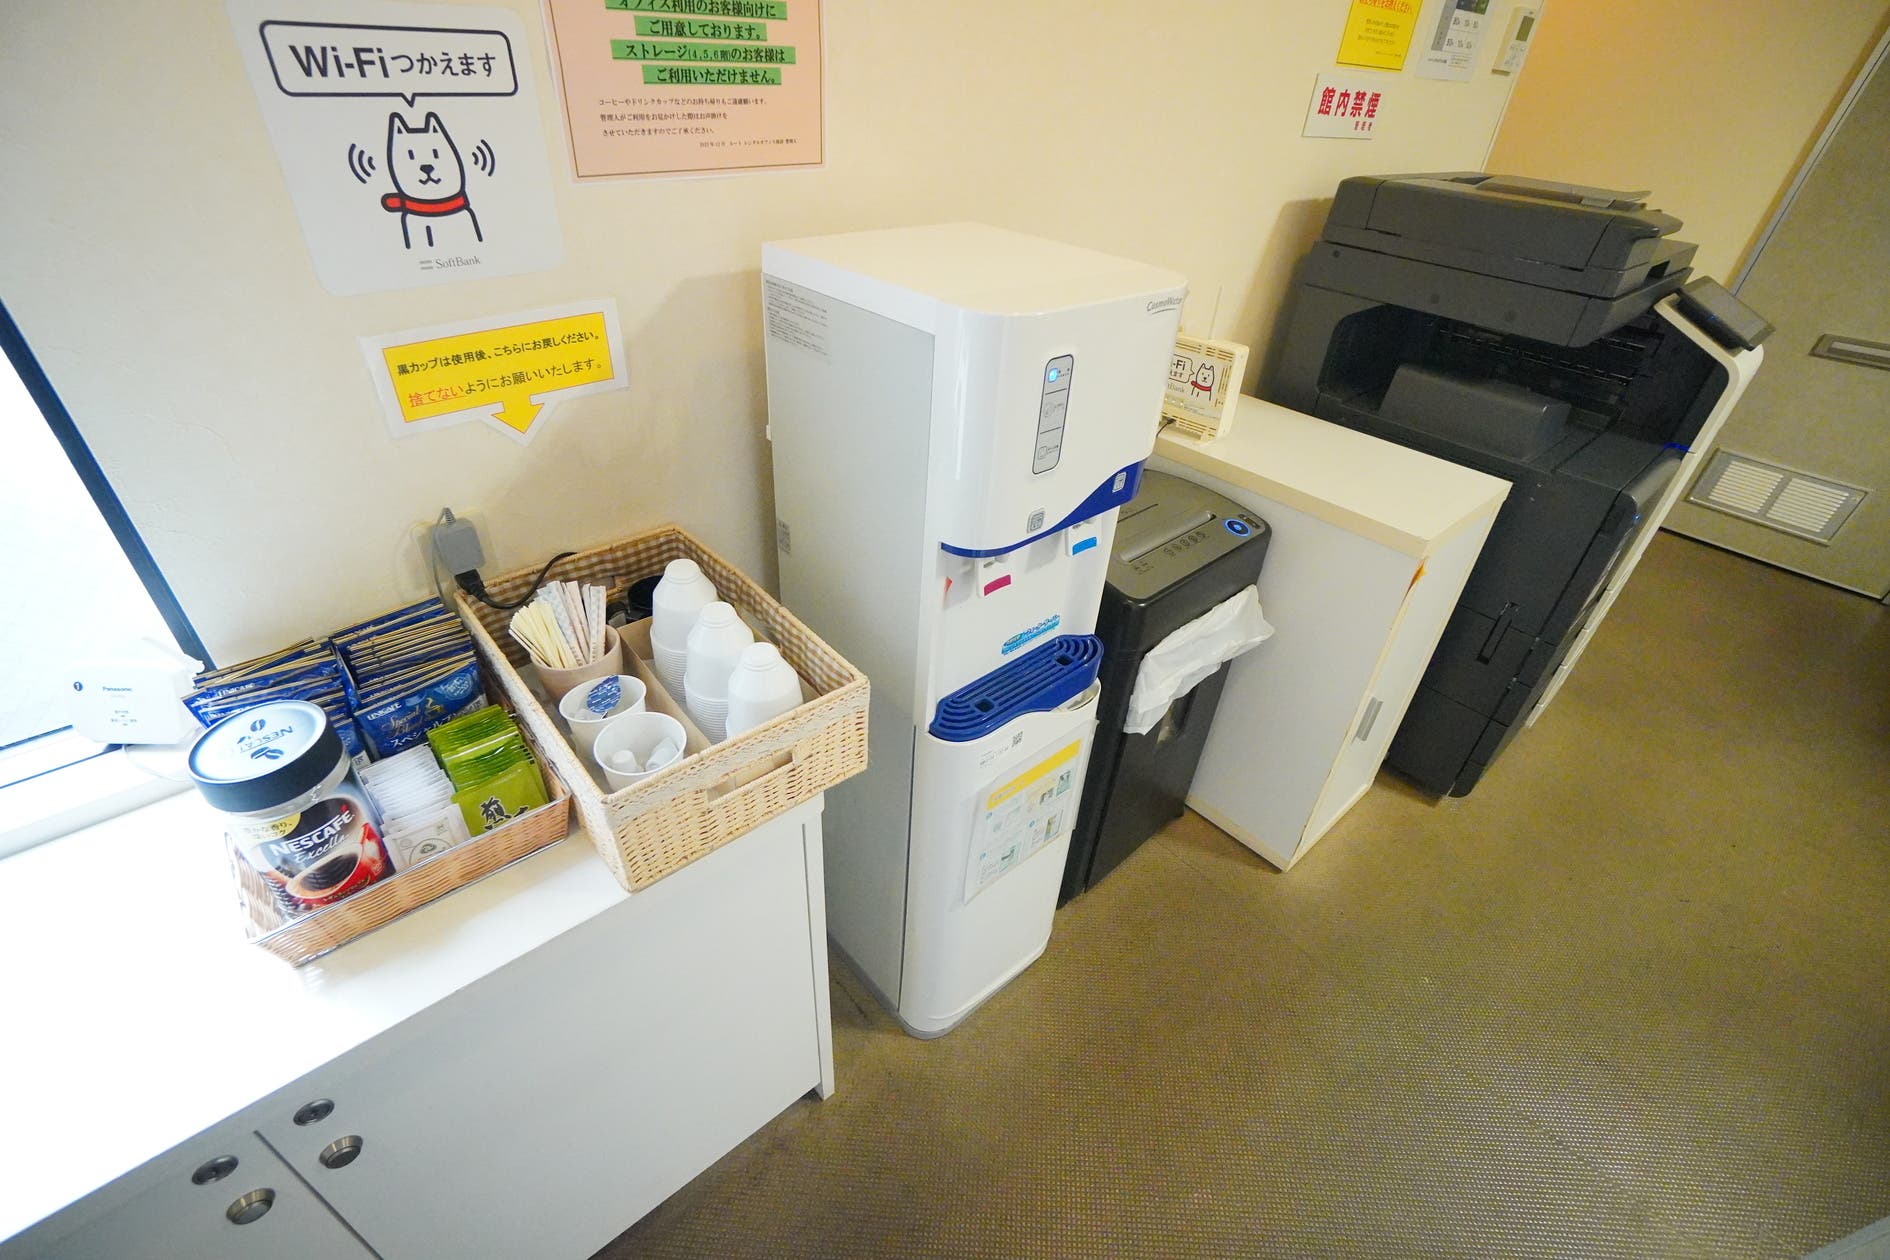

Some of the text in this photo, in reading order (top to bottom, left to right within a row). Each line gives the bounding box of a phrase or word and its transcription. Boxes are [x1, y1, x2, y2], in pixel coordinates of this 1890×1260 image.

[649, 19, 762, 41] ご用意しております。
[657, 67, 776, 84] ご利用いただけません。
[1317, 86, 1382, 118] 館内禁煙
[434, 255, 481, 270] SoftBank
[397, 331, 600, 377] 黒カップは使用後、こちらにお戻しください。
[408, 357, 602, 407] 捨てないようにお願いいたします。
